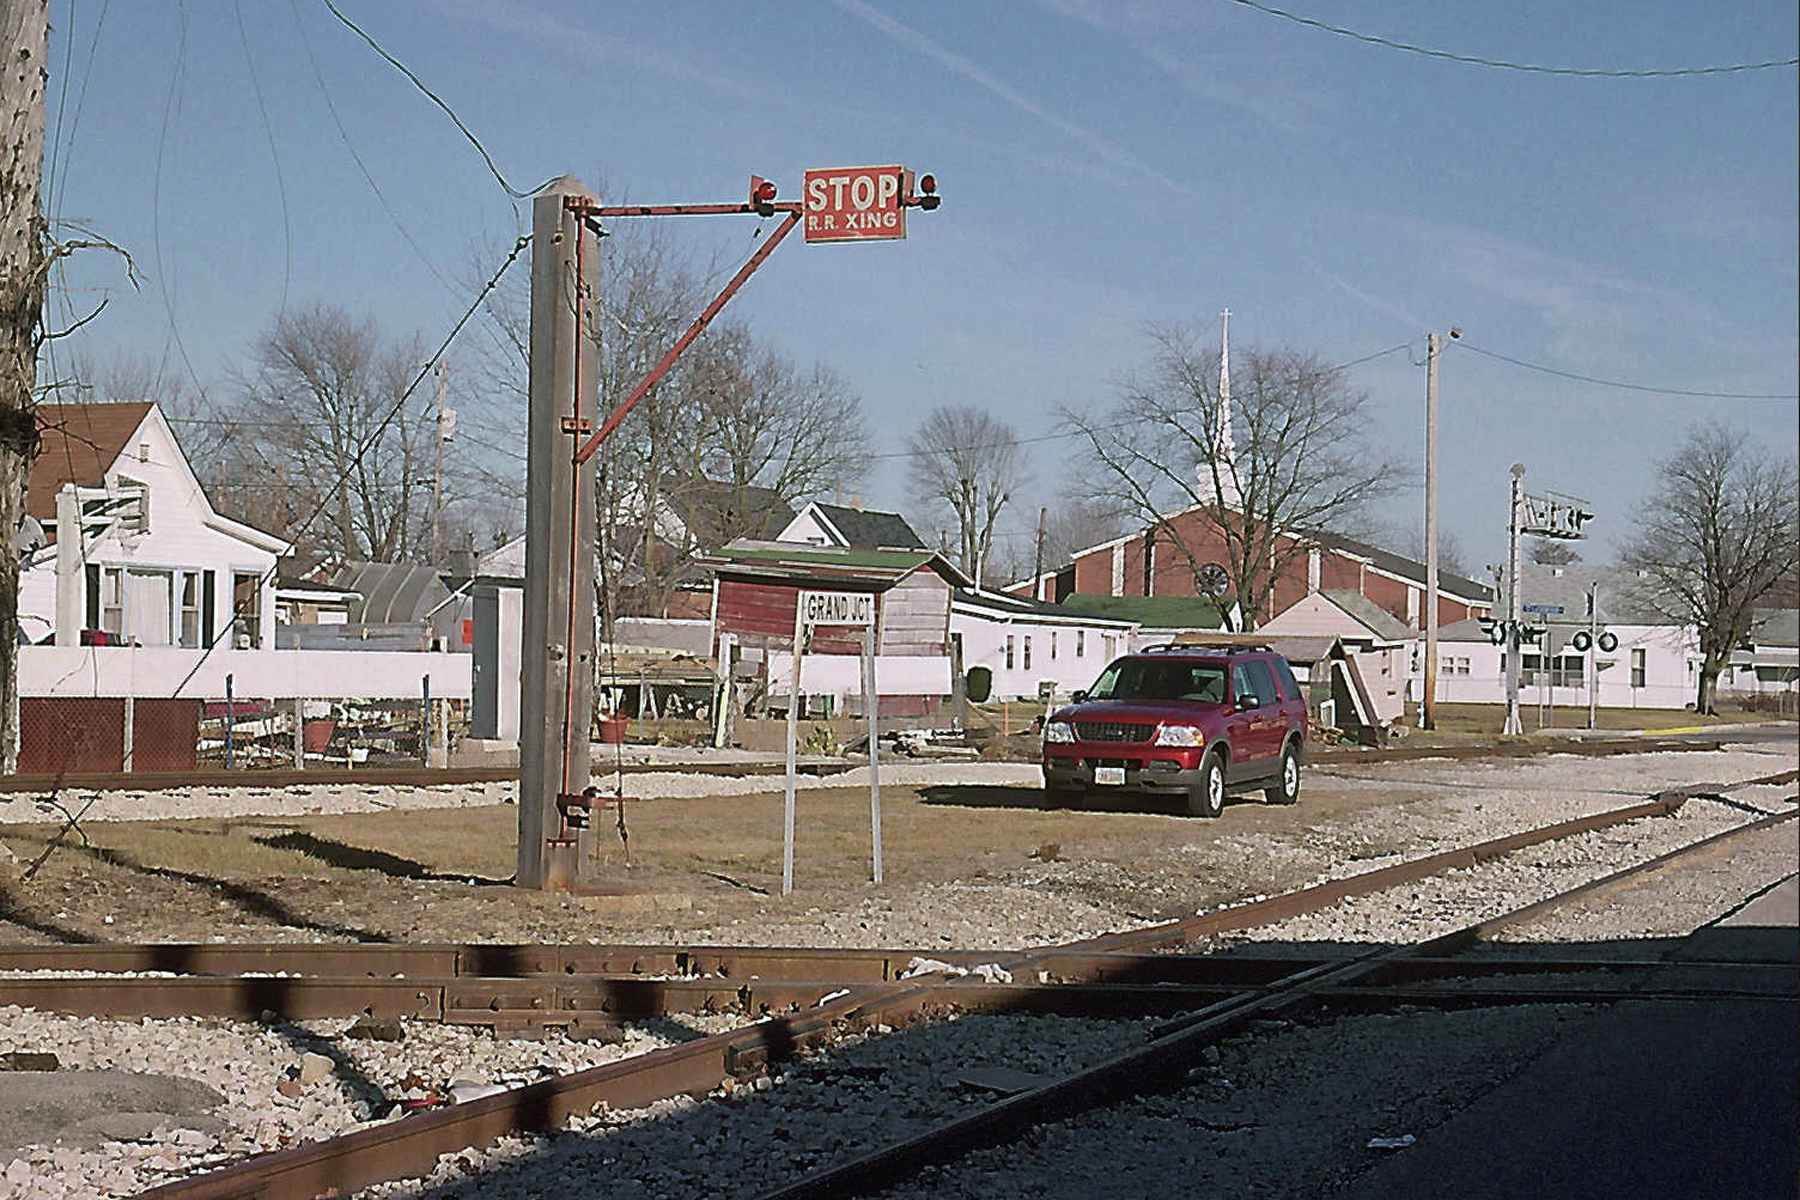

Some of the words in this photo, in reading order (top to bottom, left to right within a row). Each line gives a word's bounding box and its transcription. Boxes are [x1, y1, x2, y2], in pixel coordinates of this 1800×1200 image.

[808, 174, 898, 211] STOP
[845, 212, 897, 229] XING
[807, 594, 848, 621] GRAND
[851, 597, 871, 621] JCT
